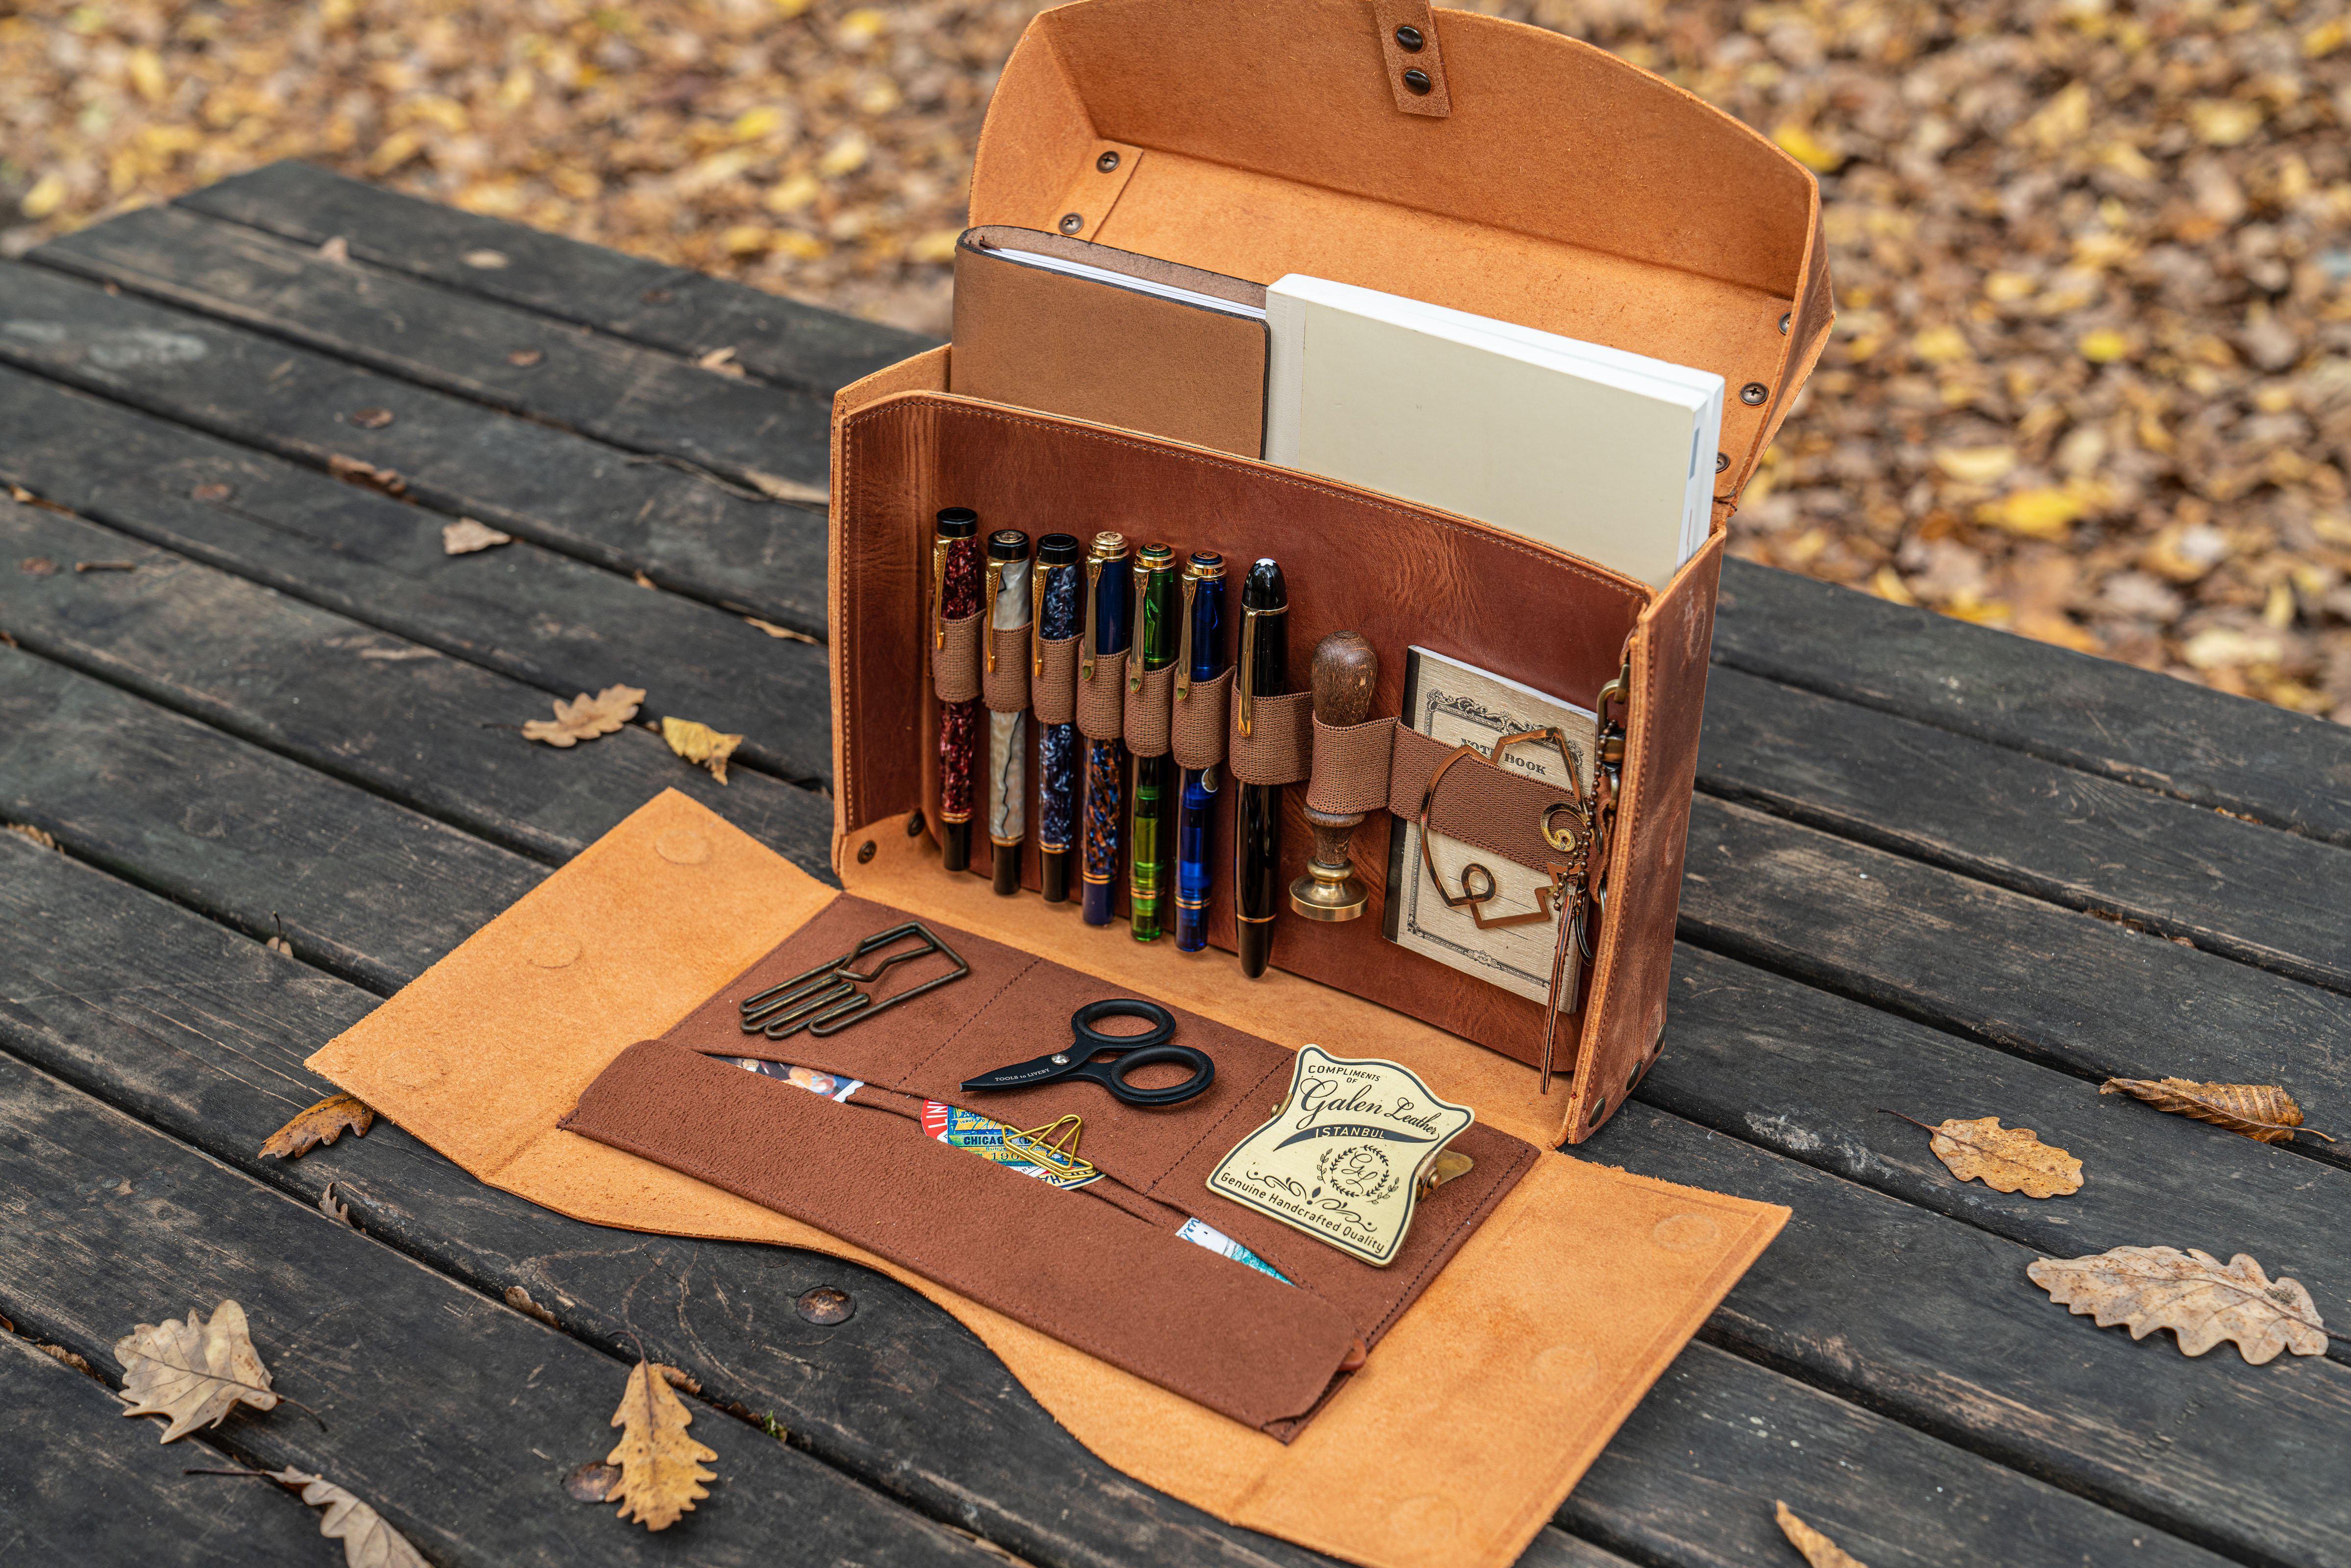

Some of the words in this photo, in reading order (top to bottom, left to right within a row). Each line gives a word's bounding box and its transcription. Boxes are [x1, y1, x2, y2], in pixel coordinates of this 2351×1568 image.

[1504, 753, 1546, 775] BOOK
[1027, 1068, 1050, 1077] LIVEBY
[1308, 1065, 1380, 1081] COMPLIMENTS
[1296, 1078, 1383, 1129] Galen
[1384, 1098, 1442, 1135] Leather
[963, 1136, 1012, 1145] CHICAG
[1316, 1127, 1385, 1139] ISTANBUL
[1221, 1173, 1266, 1199] Genuine
[1269, 1194, 1342, 1231] Handcrafted
[1343, 1226, 1385, 1254] Quality
